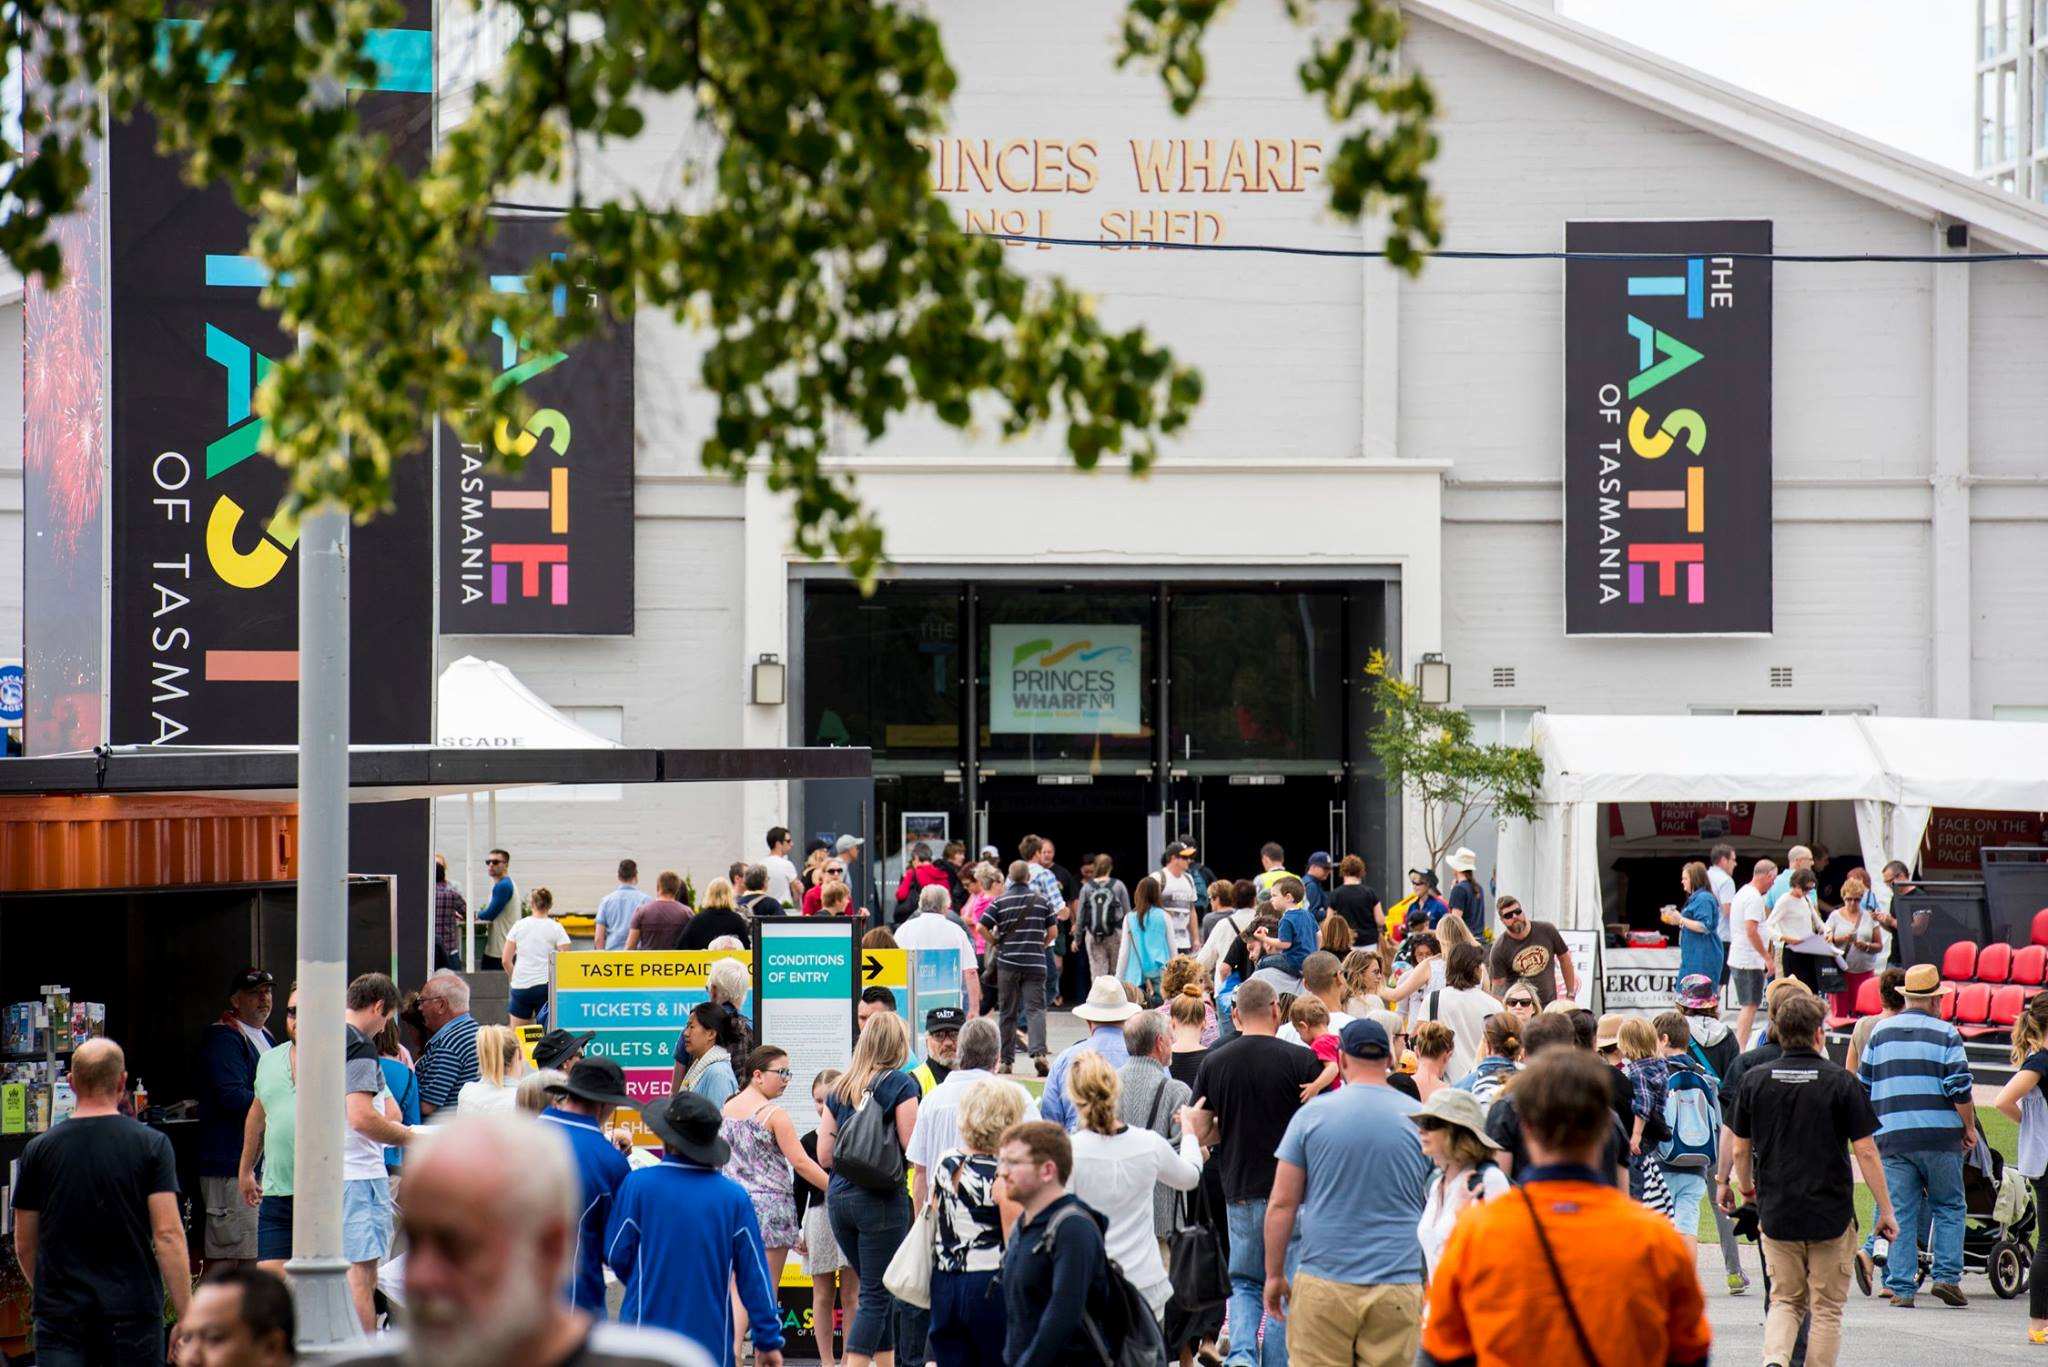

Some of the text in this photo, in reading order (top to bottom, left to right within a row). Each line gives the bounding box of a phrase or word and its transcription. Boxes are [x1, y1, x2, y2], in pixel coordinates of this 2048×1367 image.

[1129, 138, 1323, 194] WHARF
[1099, 209, 1227, 251] SHED
[1710, 257, 1734, 309] THE
[1627, 257, 1707, 604] TASTE
[152, 451, 191, 523] OF
[1598, 383, 1622, 604] OF TASMANIA
[460, 441, 484, 605] TASMANIA
[1012, 669, 1115, 692] PRINCES
[1661, 810, 1696, 820] FRONT
[1661, 821, 1687, 832] PAGE
[1938, 818, 2029, 833] FACE ON THE
[1938, 834, 1984, 847] FRONT
[1938, 850, 1973, 863] PAGE
[767, 954, 845, 966] CONDITIONS
[581, 963, 634, 977] TASTE
[767, 971, 830, 983] OF ENTRY
[580, 1002, 652, 1017] TICKETS
[656, 1002, 669, 1016] &
[584, 1042, 669, 1056] TOILETS &
